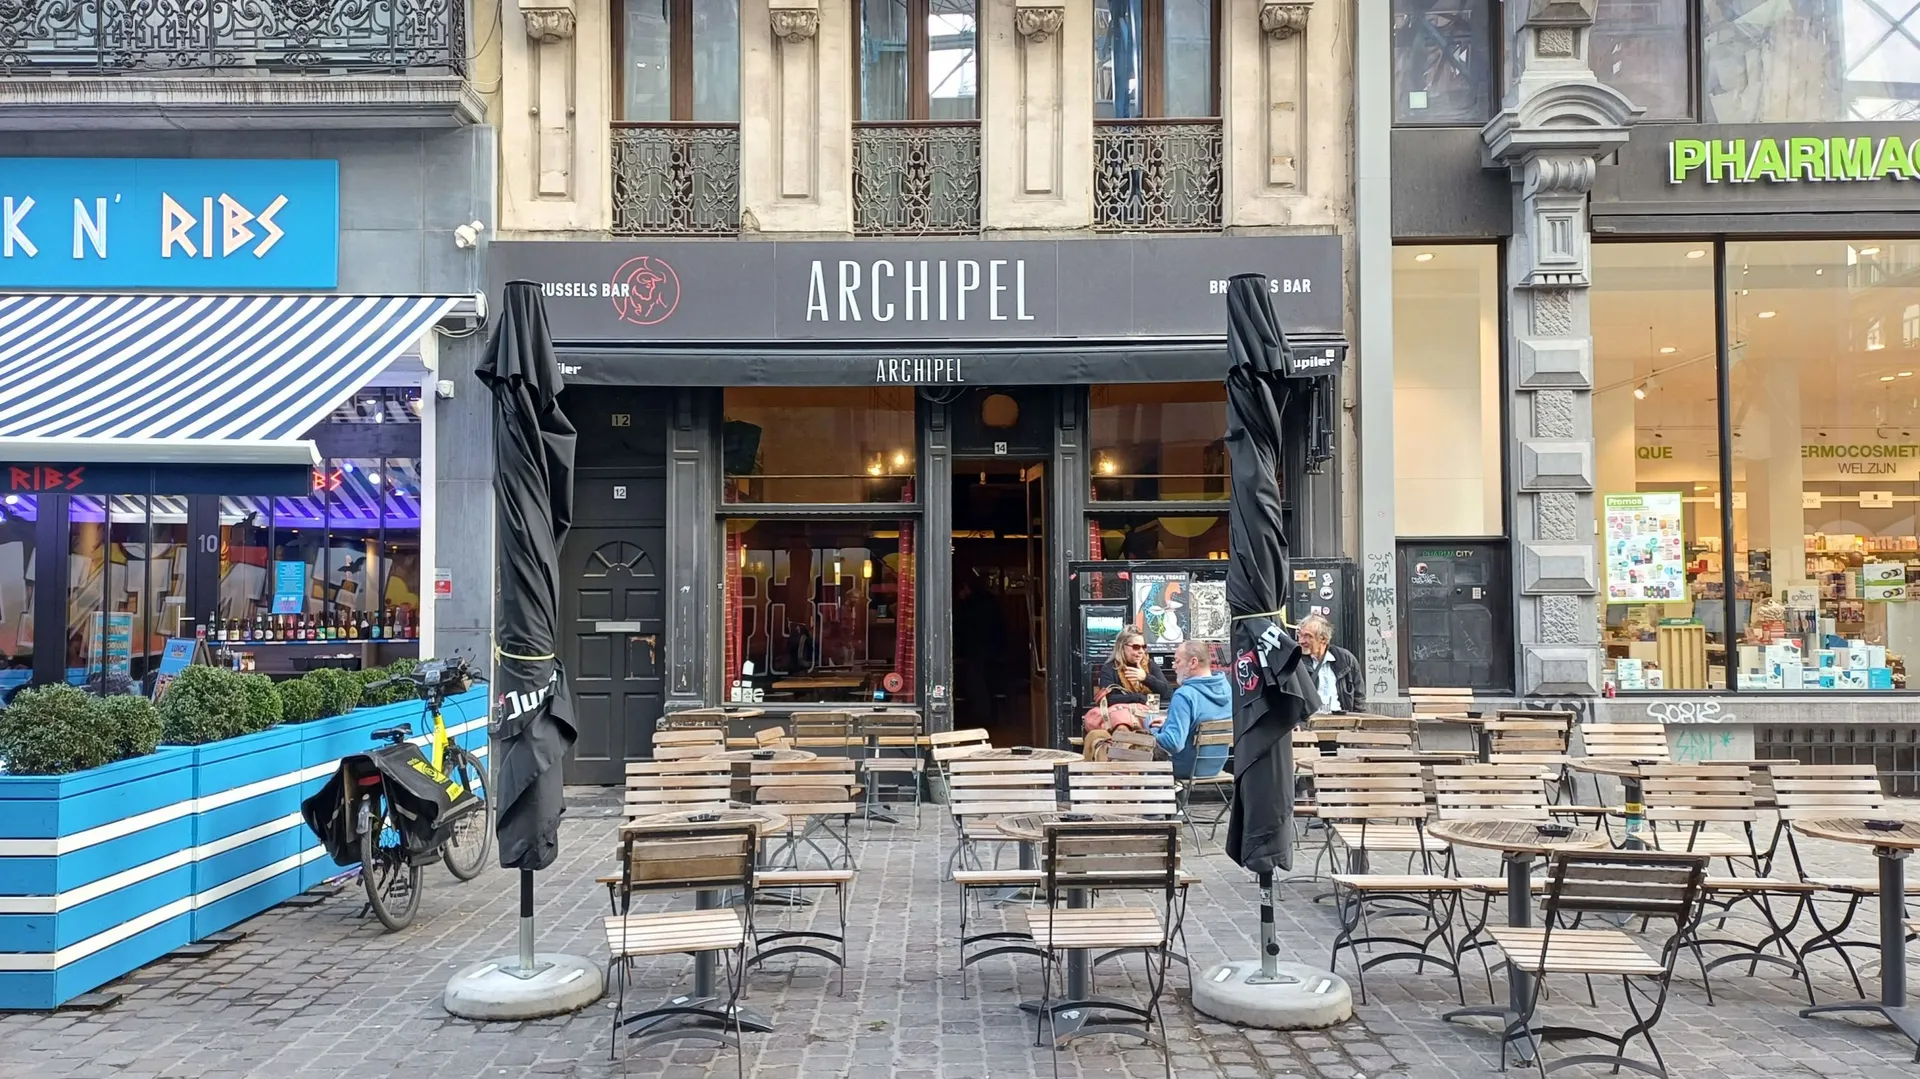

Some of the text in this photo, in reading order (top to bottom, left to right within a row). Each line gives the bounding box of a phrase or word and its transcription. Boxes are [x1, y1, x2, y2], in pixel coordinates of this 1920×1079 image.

[161, 192, 289, 259] RIBS
[541, 282, 630, 297] RUSSELS BAR
[806, 259, 1035, 322] ARCHIPEL
[1283, 278, 1312, 293] BAR
[875, 357, 965, 383] ARCHIPEL
[1293, 356, 1335, 371] upiler
[615, 415, 629, 426] 12
[995, 443, 1006, 453] 14
[1635, 446, 1673, 460] QUE
[1838, 462, 1897, 474] WELZIJN
[9, 466, 85, 491] RIBS
[615, 488, 626, 497] 12
[1608, 497, 1642, 505] Promos
[198, 534, 218, 554] 10
